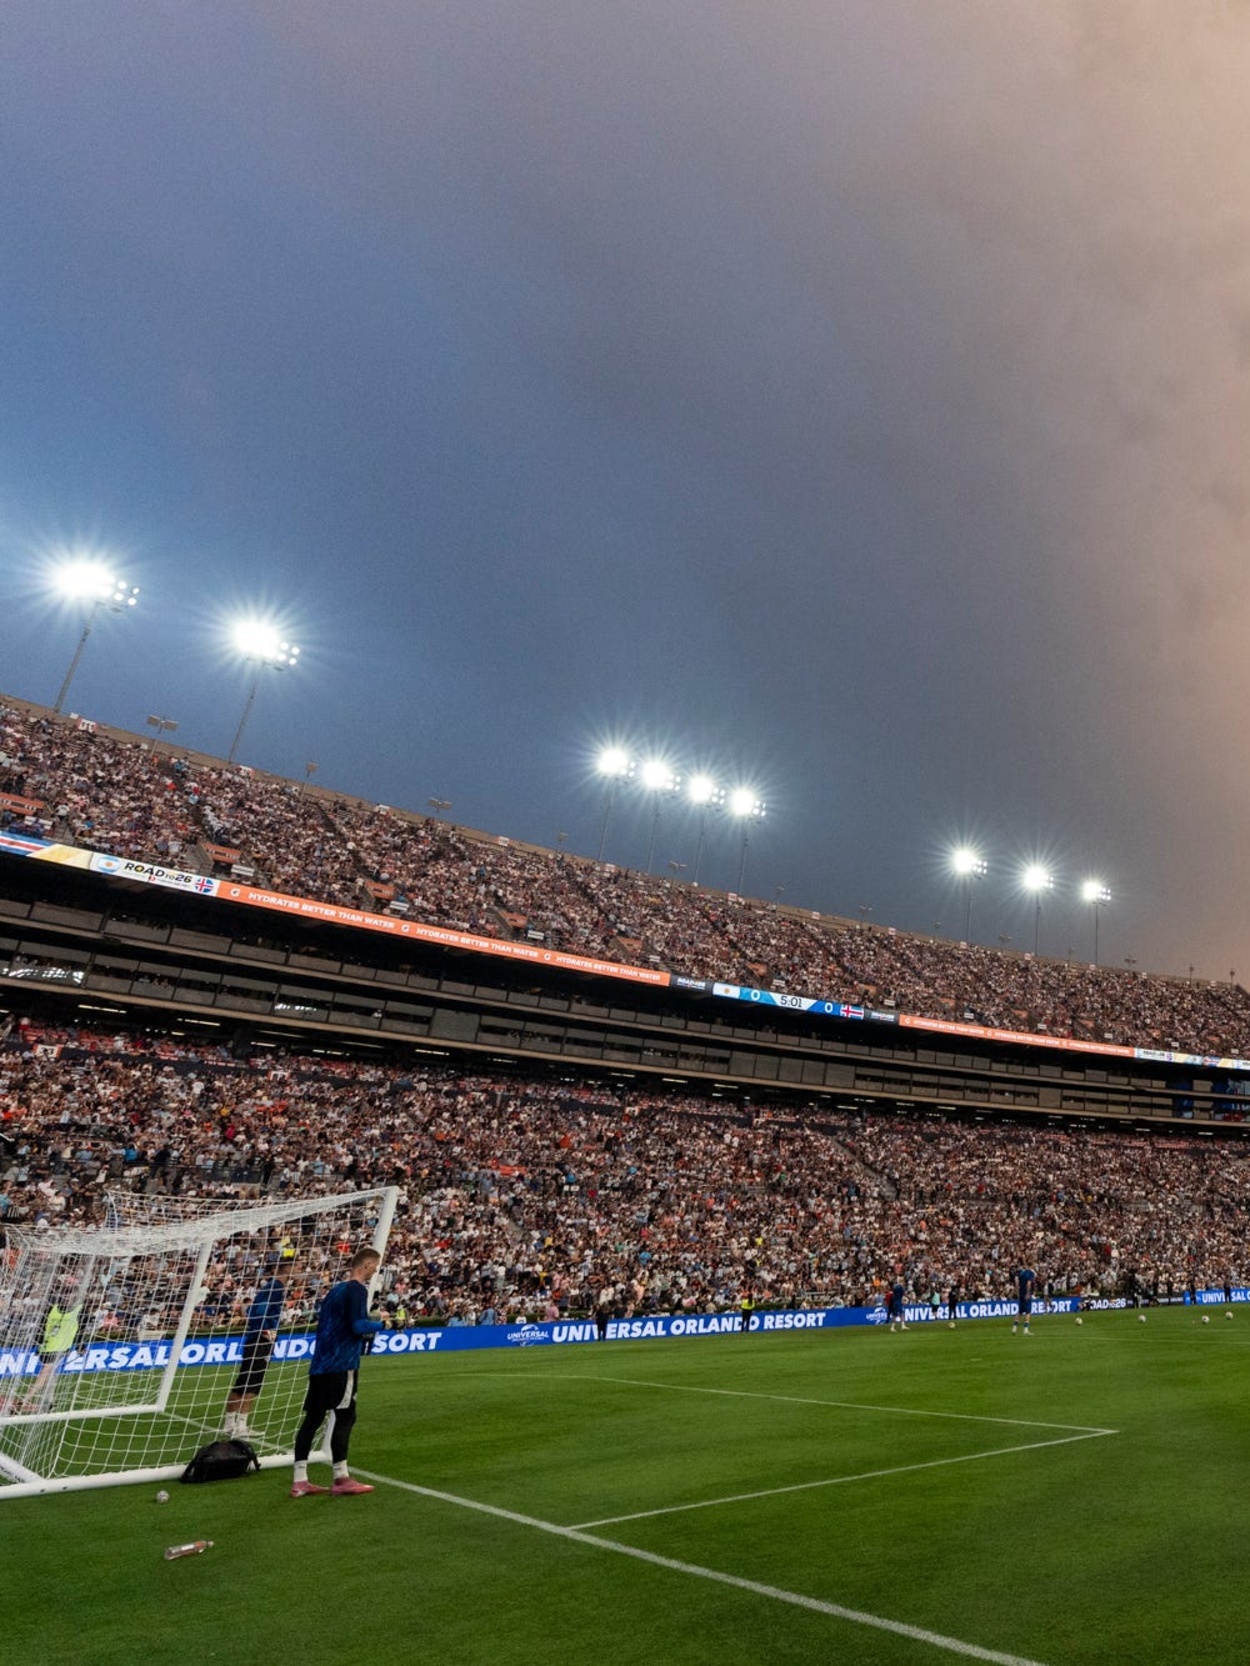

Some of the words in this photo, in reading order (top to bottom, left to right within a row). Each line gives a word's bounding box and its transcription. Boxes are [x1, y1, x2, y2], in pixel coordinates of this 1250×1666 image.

[124, 862, 165, 877] ROAD
[249, 892, 300, 909] HYDRATES
[301, 903, 336, 917] BETTER
[338, 911, 363, 923] THAN
[364, 917, 395, 929] WATER
[416, 928, 459, 941] HYDRATES
[491, 943, 512, 953] THAN
[513, 947, 539, 958] WATER
[751, 990, 761, 1001] 0
[780, 995, 803, 1008] 5:01
[824, 1002, 834, 1014] 0
[970, 1302, 1019, 1318] ORLAND
[763, 1312, 827, 1330] RESORT
